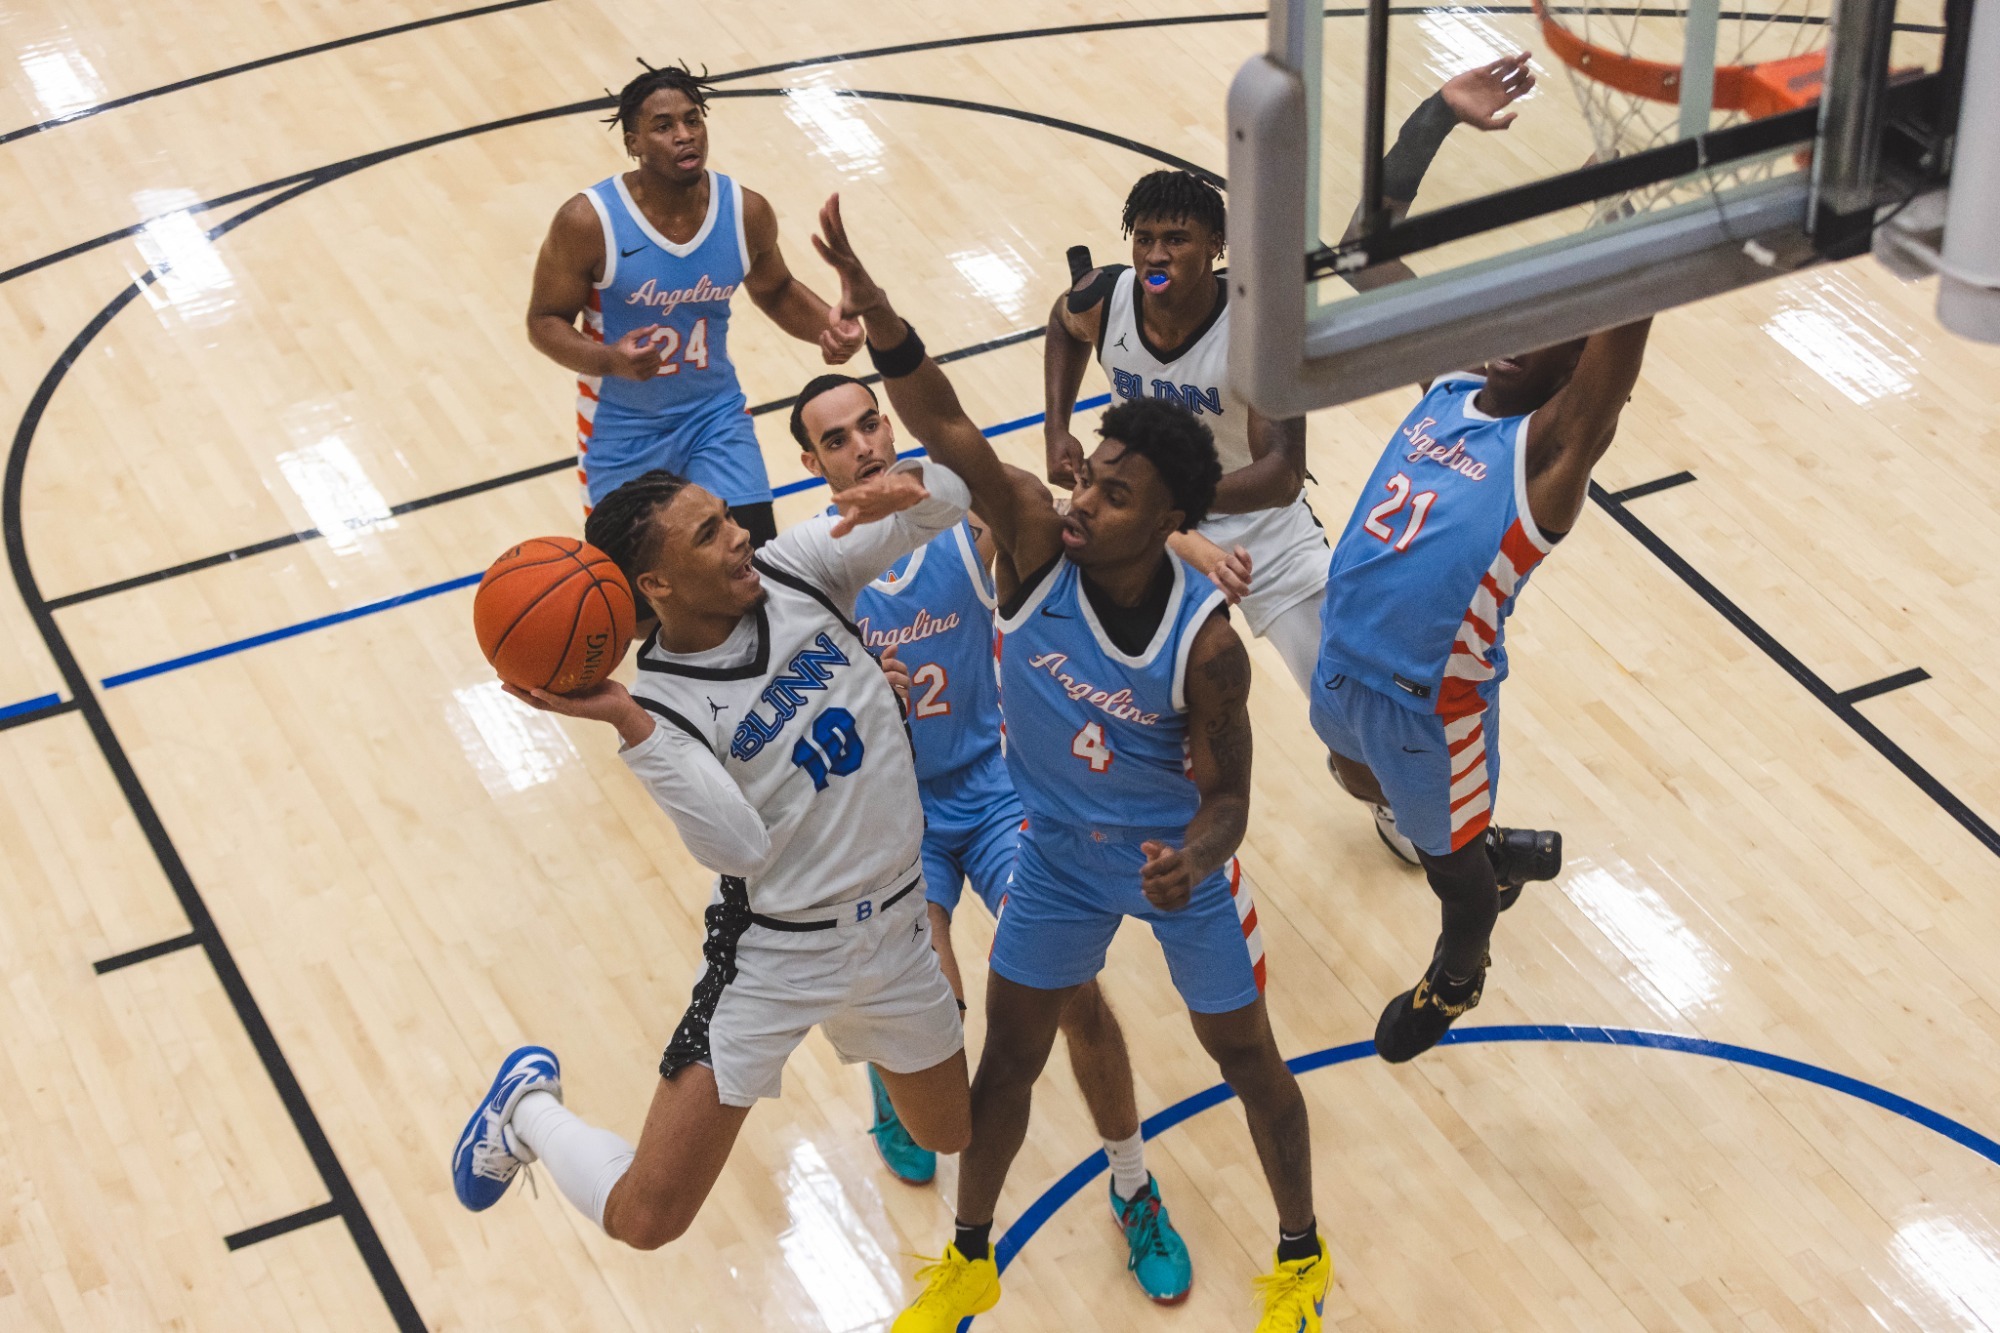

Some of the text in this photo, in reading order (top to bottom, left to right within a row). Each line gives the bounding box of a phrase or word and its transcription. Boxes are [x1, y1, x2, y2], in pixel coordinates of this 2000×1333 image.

[624, 274, 734, 316] Angelina
[650, 317, 709, 377] 24
[1402, 416, 1488, 482] Angelina
[1363, 470, 1439, 554] 21
[576, 634, 609, 687] DING
[1028, 652, 1161, 726] Angelina
[730, 632, 851, 762] BLINN
[902, 662, 952, 721] 2
[791, 706, 865, 793] 10
[1072, 720, 1115, 774] 4
[856, 900, 873, 922] B
